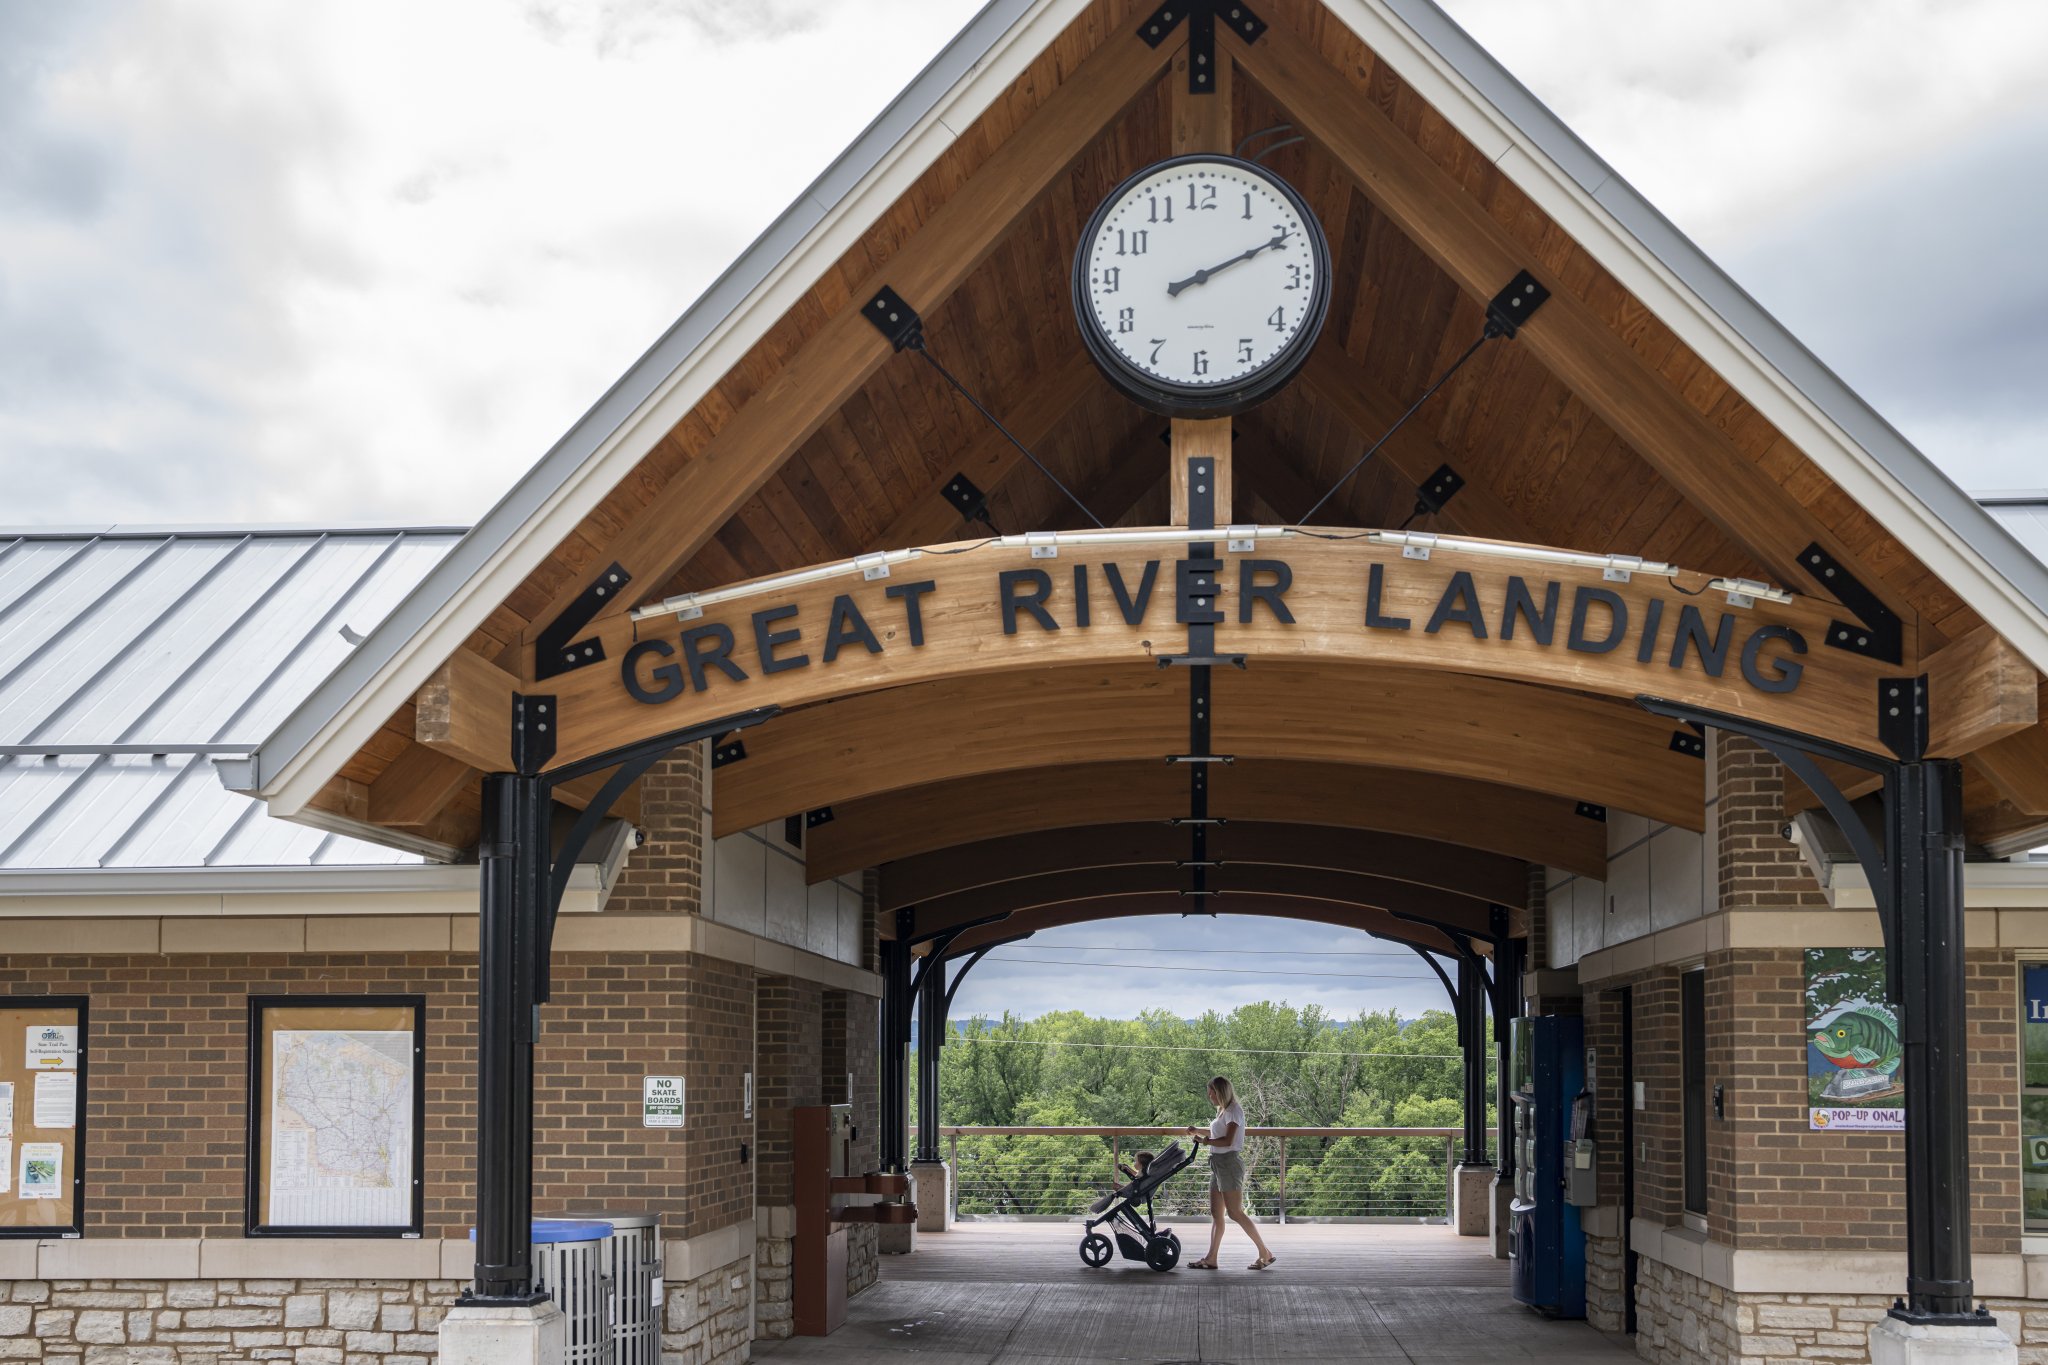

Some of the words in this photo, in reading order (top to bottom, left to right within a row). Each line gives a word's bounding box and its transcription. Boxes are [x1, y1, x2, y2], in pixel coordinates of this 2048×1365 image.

[1146, 195, 1175, 224] 11
[1185, 182, 1219, 211] 12
[1241, 192, 1254, 221] 1
[1115, 228, 1148, 257] 10
[1102, 266, 1121, 294] 9
[1283, 263, 1301, 290] 3
[1117, 306, 1135, 334] 8
[1267, 305, 1287, 332] 4
[1149, 338, 1167, 366] 7
[1191, 349, 1210, 376] 6
[1236, 338, 1253, 364] 5
[621, 580, 936, 705] GREAT
[999, 559, 1297, 636] RIVER
[1365, 563, 1808, 694] LANDING
[657, 1080, 672, 1088] NO
[1832, 1110, 1869, 1121] POP-UP
[1873, 1110, 1904, 1123] ONAL
